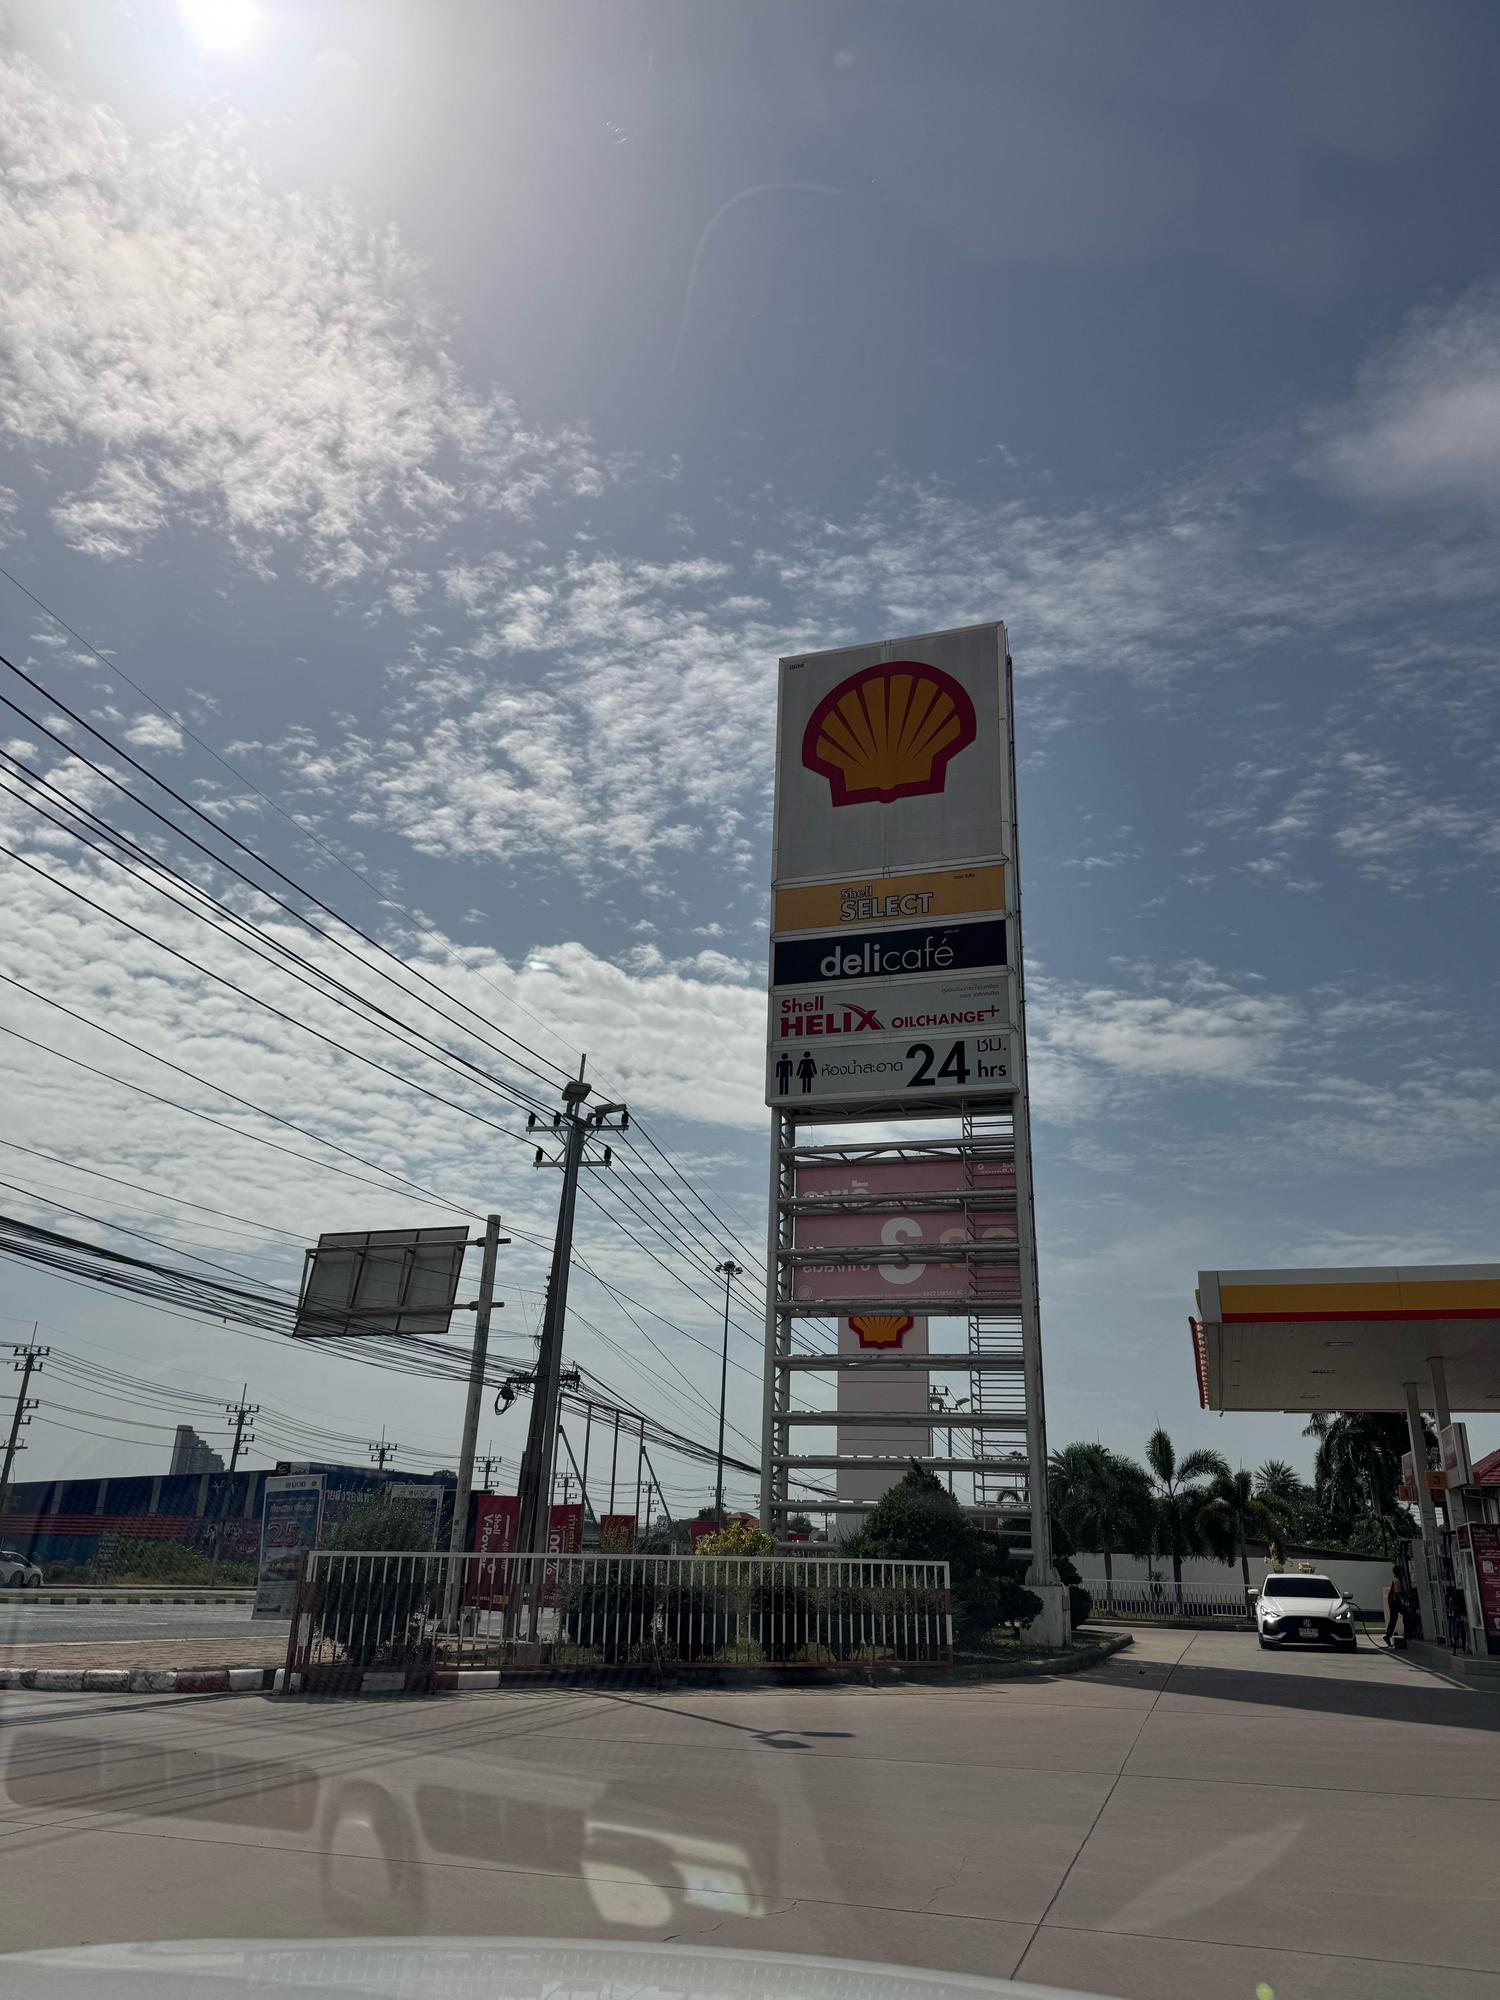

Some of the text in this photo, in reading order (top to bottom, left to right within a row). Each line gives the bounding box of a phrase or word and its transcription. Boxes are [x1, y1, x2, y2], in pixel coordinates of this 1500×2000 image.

[840, 885, 873, 900] Shell
[840, 892, 933, 921] SELECT
[820, 936, 954, 977] delicafé
[781, 996, 824, 1014] Shell
[780, 1003, 885, 1038] HELIX
[821, 1040, 970, 1087] ห้องน้ำสะอาด 24
[977, 1059, 1007, 1078] hrs
[1432, 1475, 1441, 1485] 3
[493, 1513, 502, 1535] Shell
